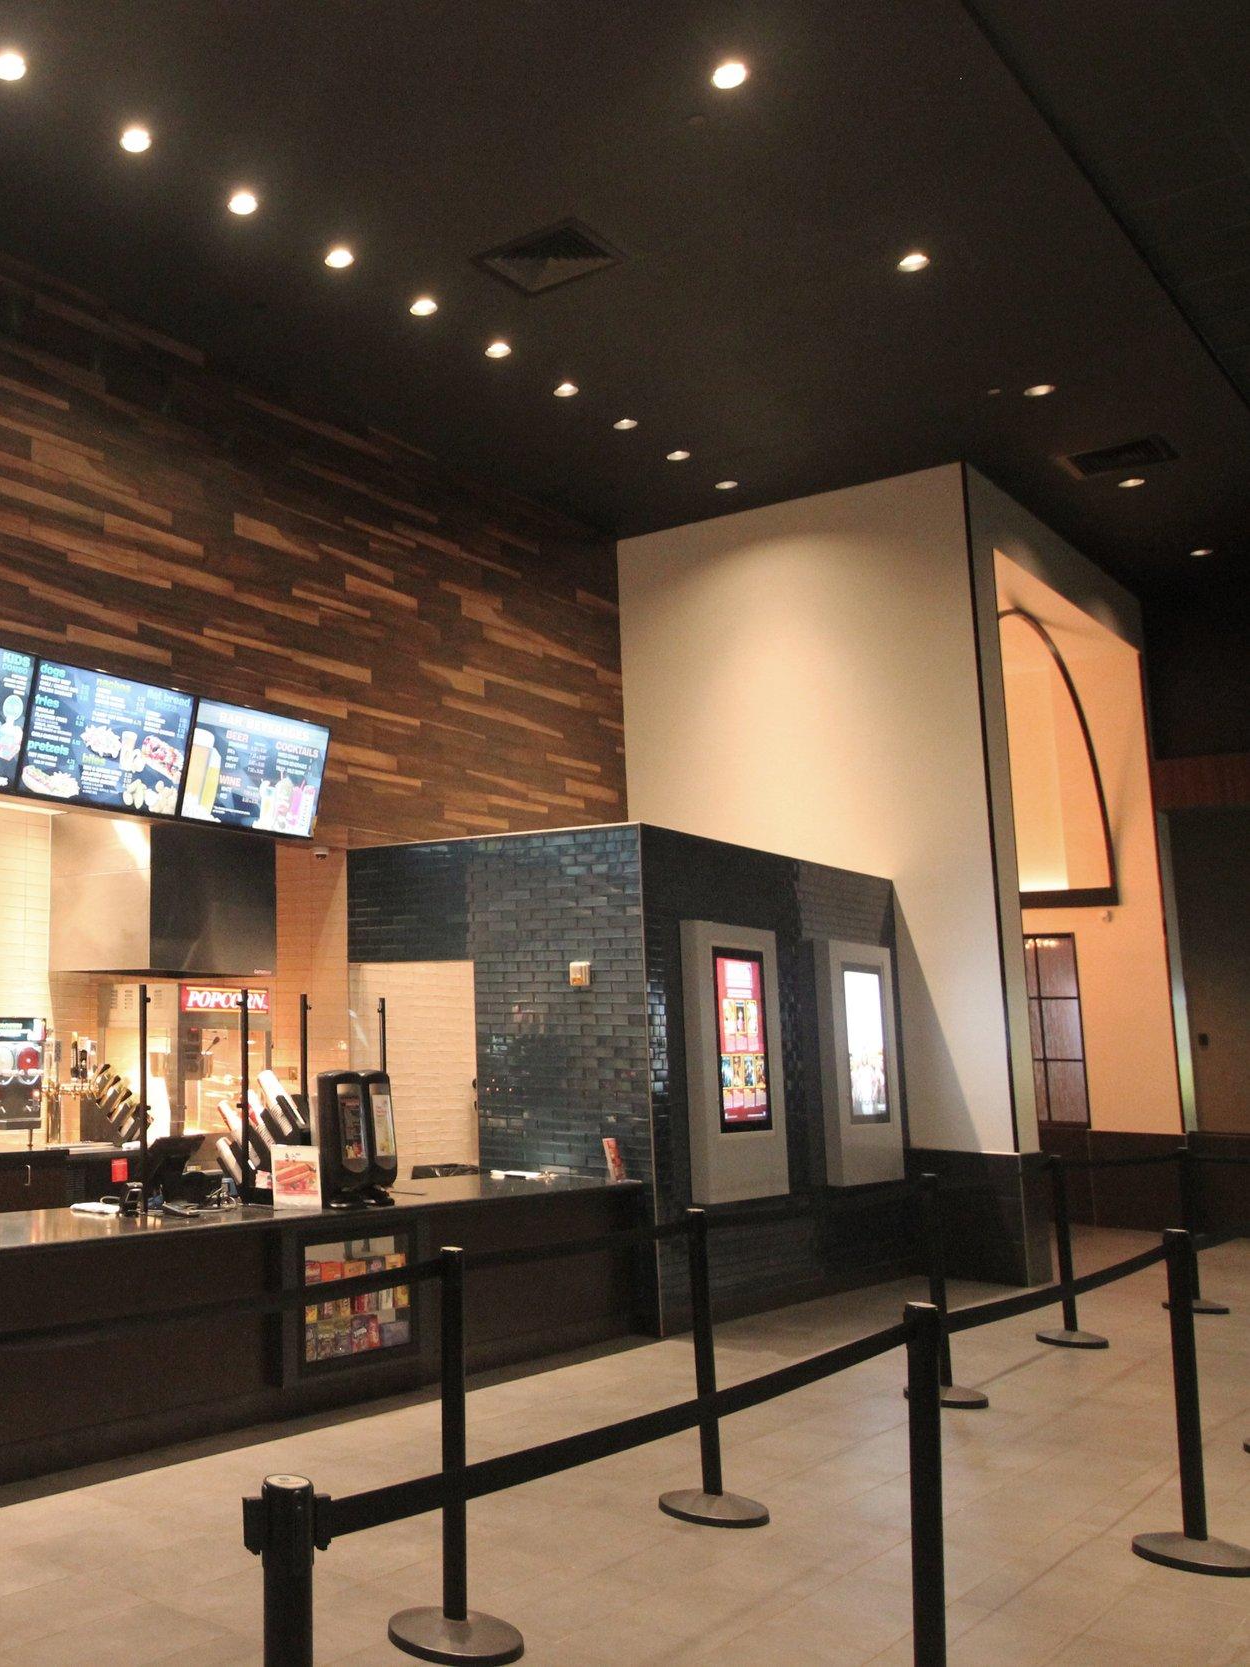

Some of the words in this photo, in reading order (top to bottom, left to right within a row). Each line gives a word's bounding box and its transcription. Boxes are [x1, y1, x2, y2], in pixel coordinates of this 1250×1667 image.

[2, 651, 31, 668] KIDS
[40, 663, 66, 679] dogs
[35, 693, 60, 709] fries
[225, 729, 249, 743] BEER
[27, 740, 70, 756] pretzels
[275, 740, 320, 759] COCKTAILS
[219, 774, 242, 788] WINE
[187, 990, 266, 1010] POPCORN
